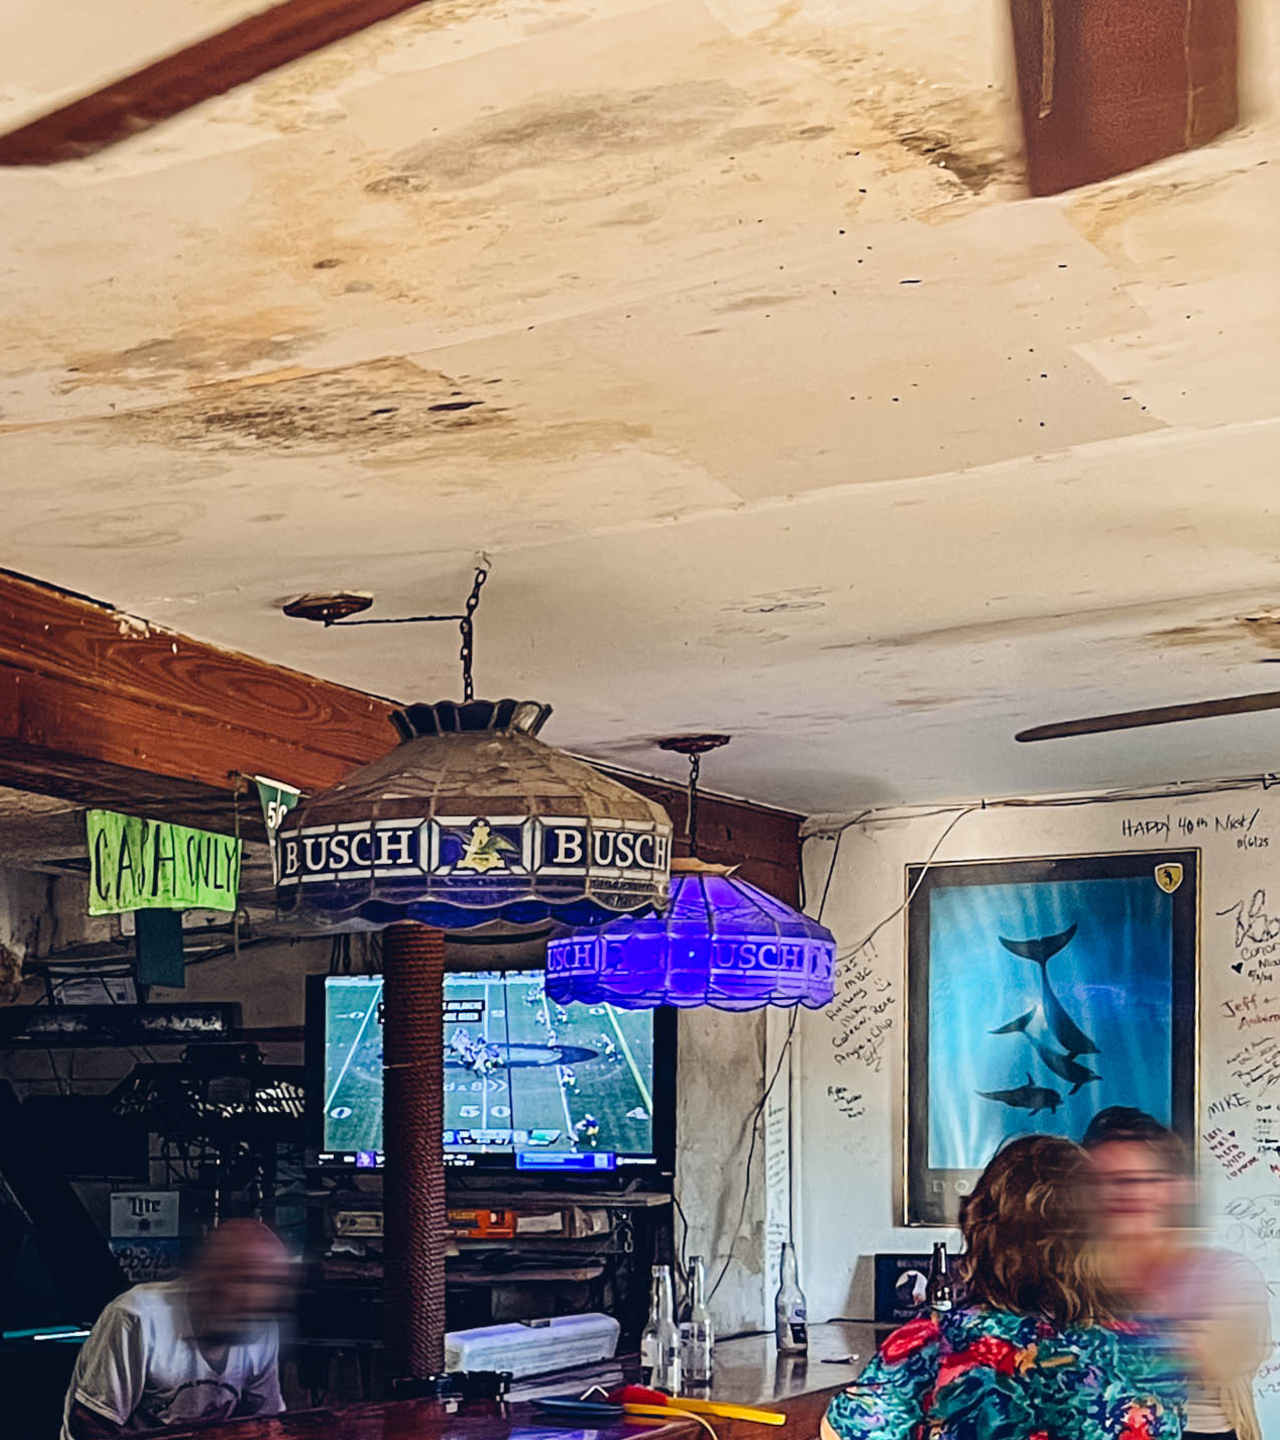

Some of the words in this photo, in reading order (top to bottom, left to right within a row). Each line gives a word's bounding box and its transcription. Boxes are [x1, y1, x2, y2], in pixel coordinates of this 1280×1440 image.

[94, 820, 177, 901] CASH
[285, 829, 414, 875] BUSCH
[553, 829, 667, 871] BUSCH
